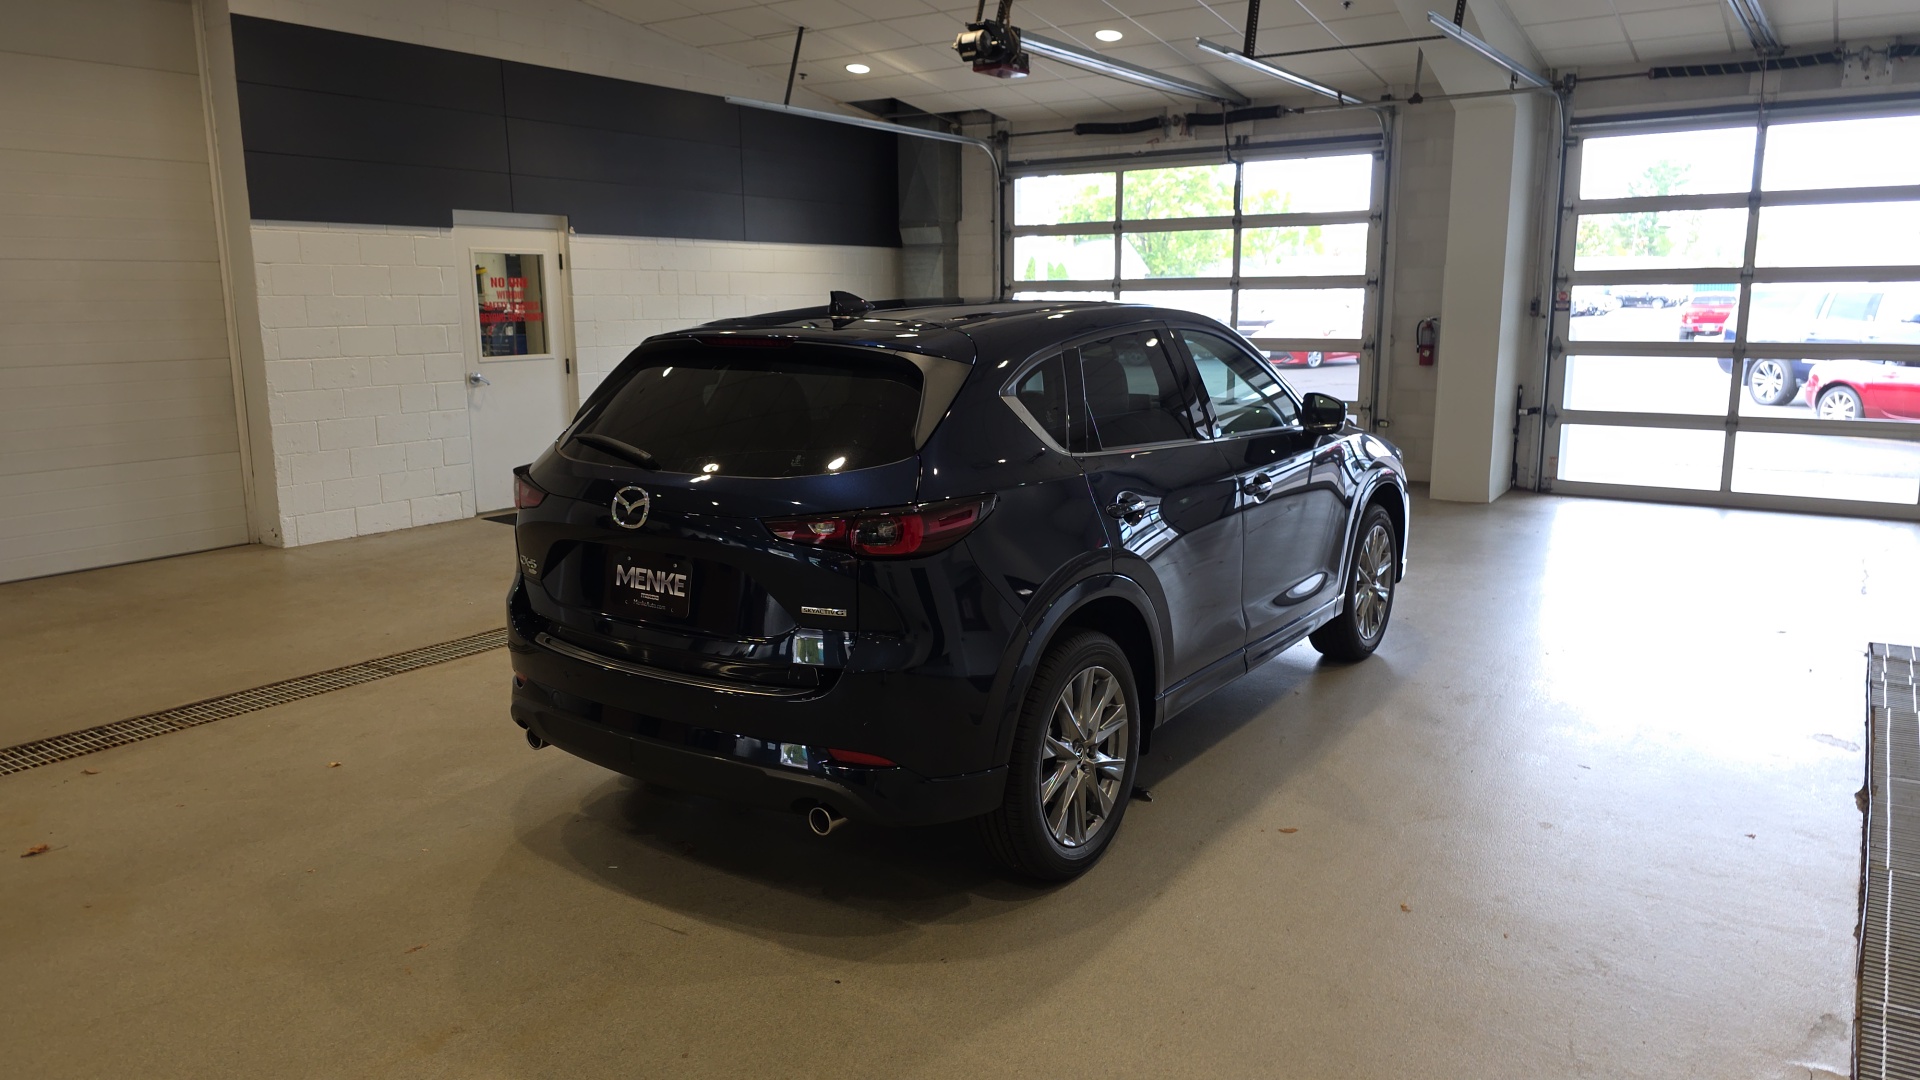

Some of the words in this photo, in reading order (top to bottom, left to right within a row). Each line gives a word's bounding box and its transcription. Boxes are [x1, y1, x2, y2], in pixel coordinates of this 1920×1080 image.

[490, 277, 505, 288] NO
[508, 277, 528, 288] ONE
[616, 564, 686, 597] MENKE
